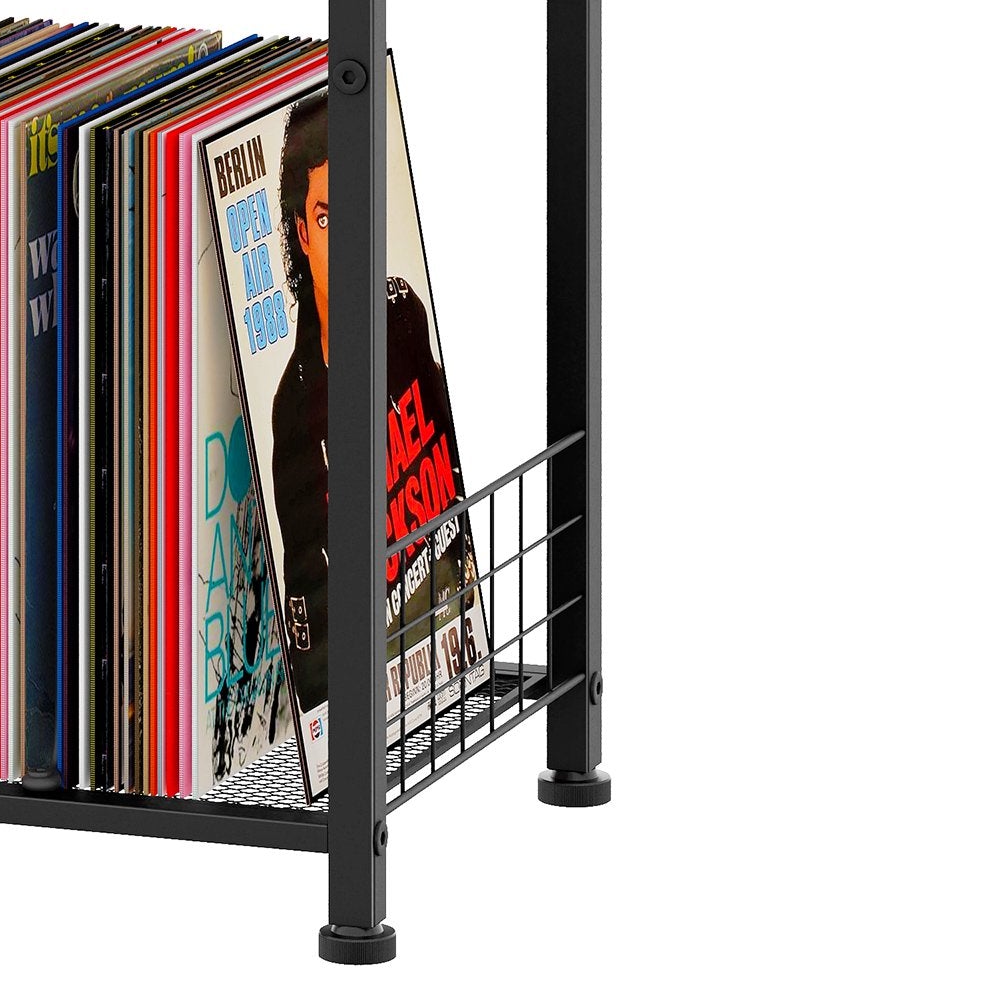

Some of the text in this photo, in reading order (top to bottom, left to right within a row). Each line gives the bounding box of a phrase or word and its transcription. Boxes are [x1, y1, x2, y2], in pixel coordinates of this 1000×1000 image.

[214, 134, 267, 199] BERLIN
[226, 188, 272, 254] OPEN
[242, 242, 274, 302] AIR
[243, 290, 289, 355] 1988
[204, 577, 281, 704] BLUE
